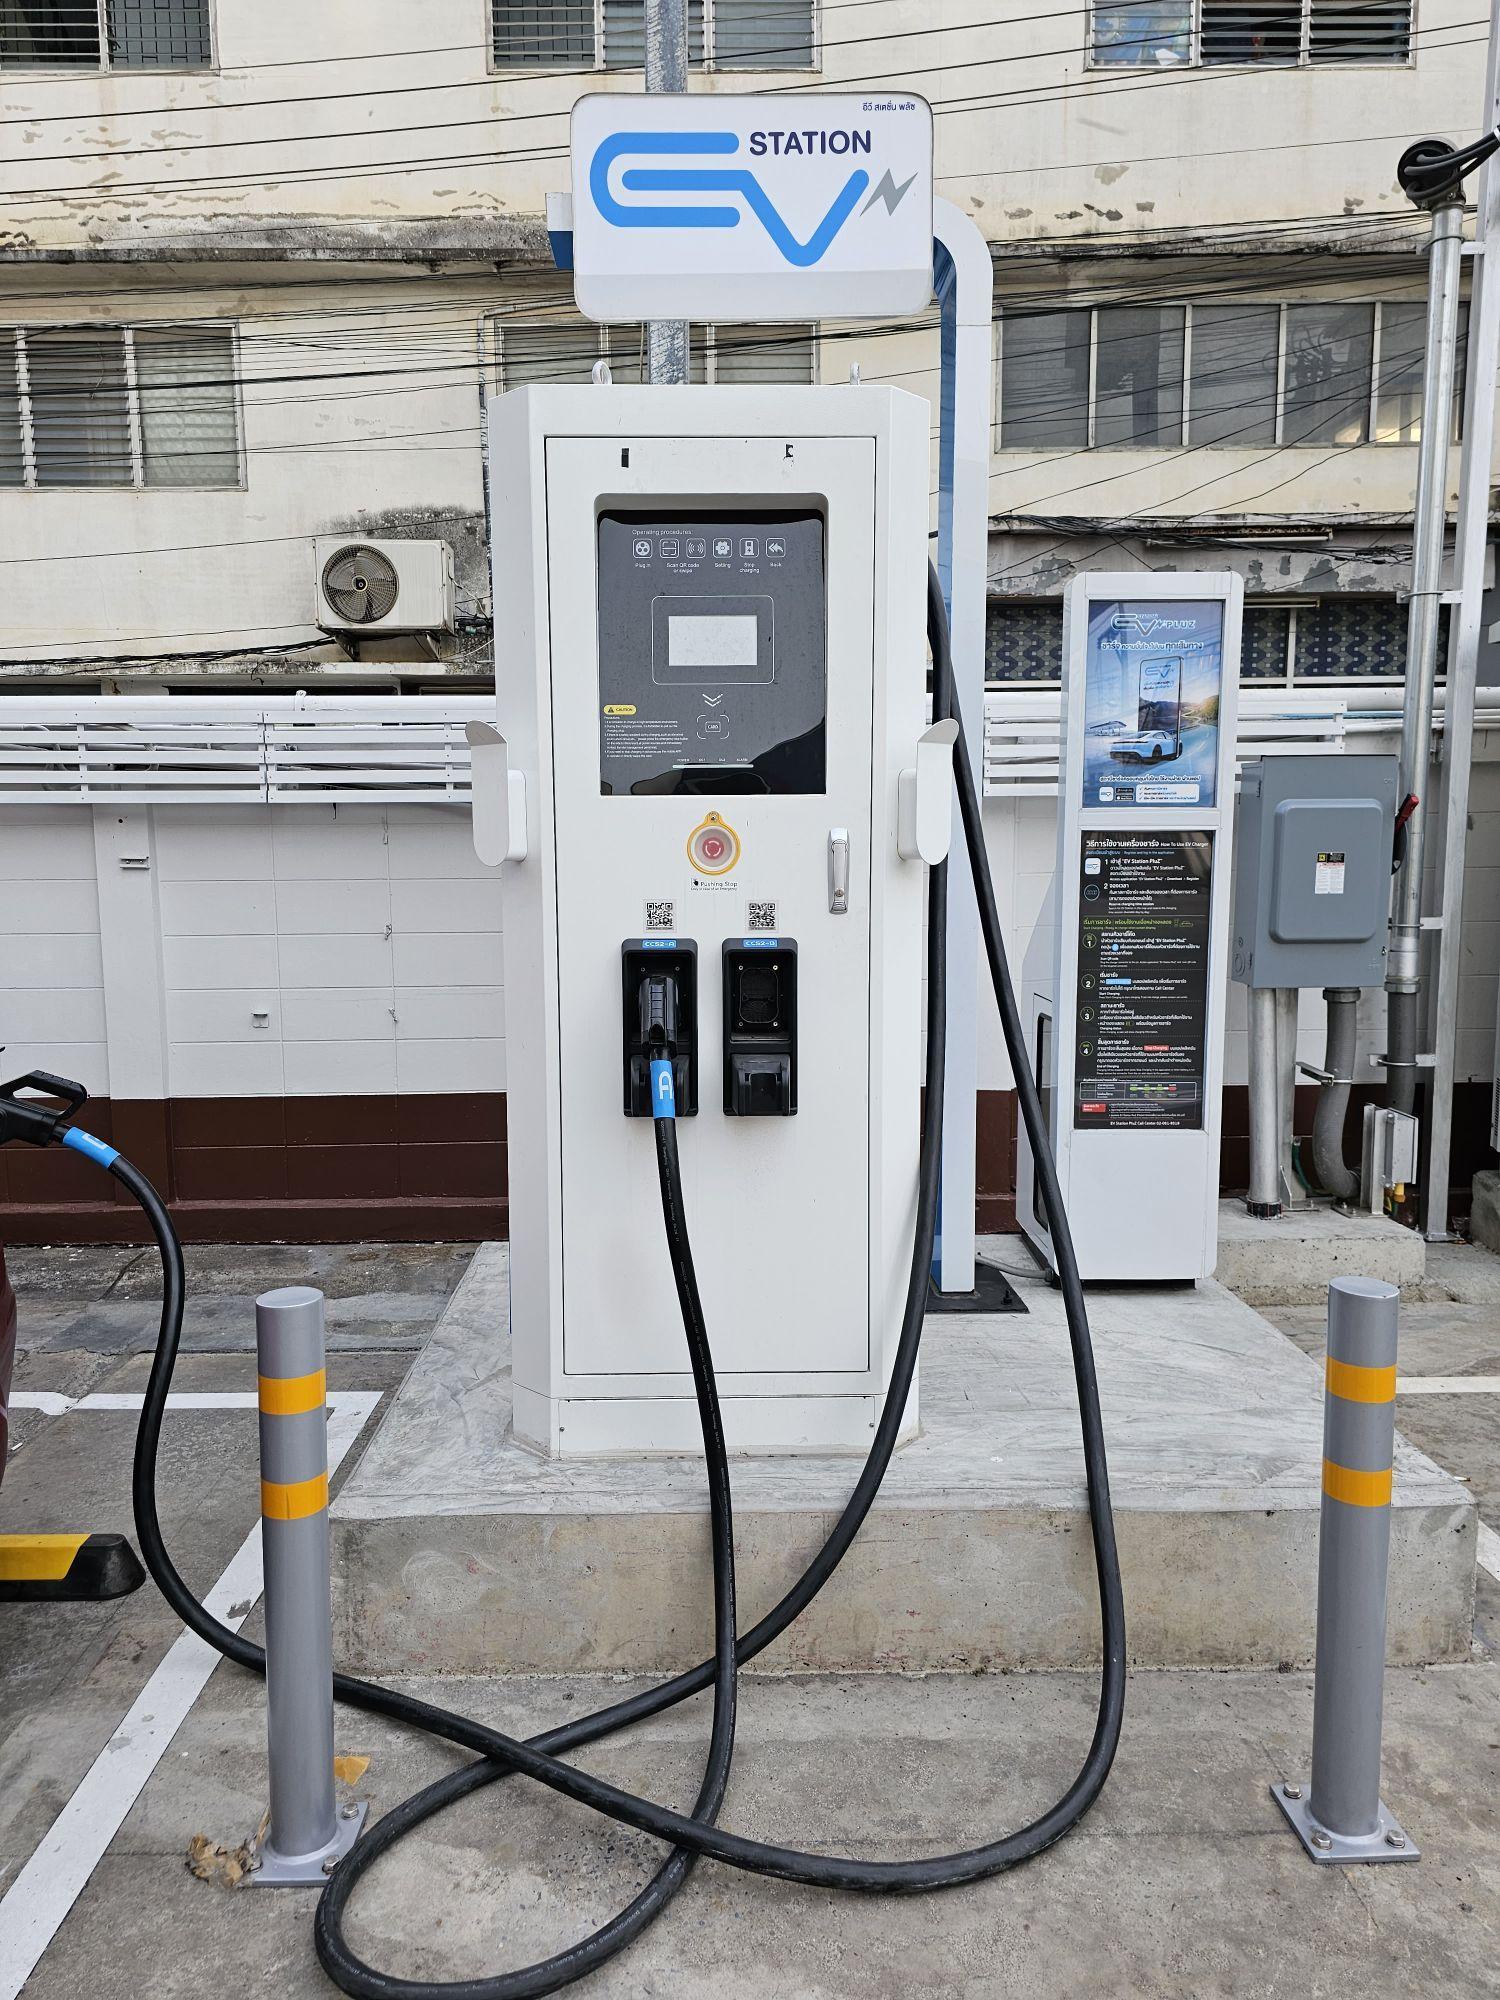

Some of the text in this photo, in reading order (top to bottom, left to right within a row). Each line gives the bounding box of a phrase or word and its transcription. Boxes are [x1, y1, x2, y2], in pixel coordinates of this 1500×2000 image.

[749, 130, 872, 156] STATION
[589, 132, 870, 268] EV
[1167, 620, 1196, 630] PLUZ
[658, 1070, 673, 1100] A
